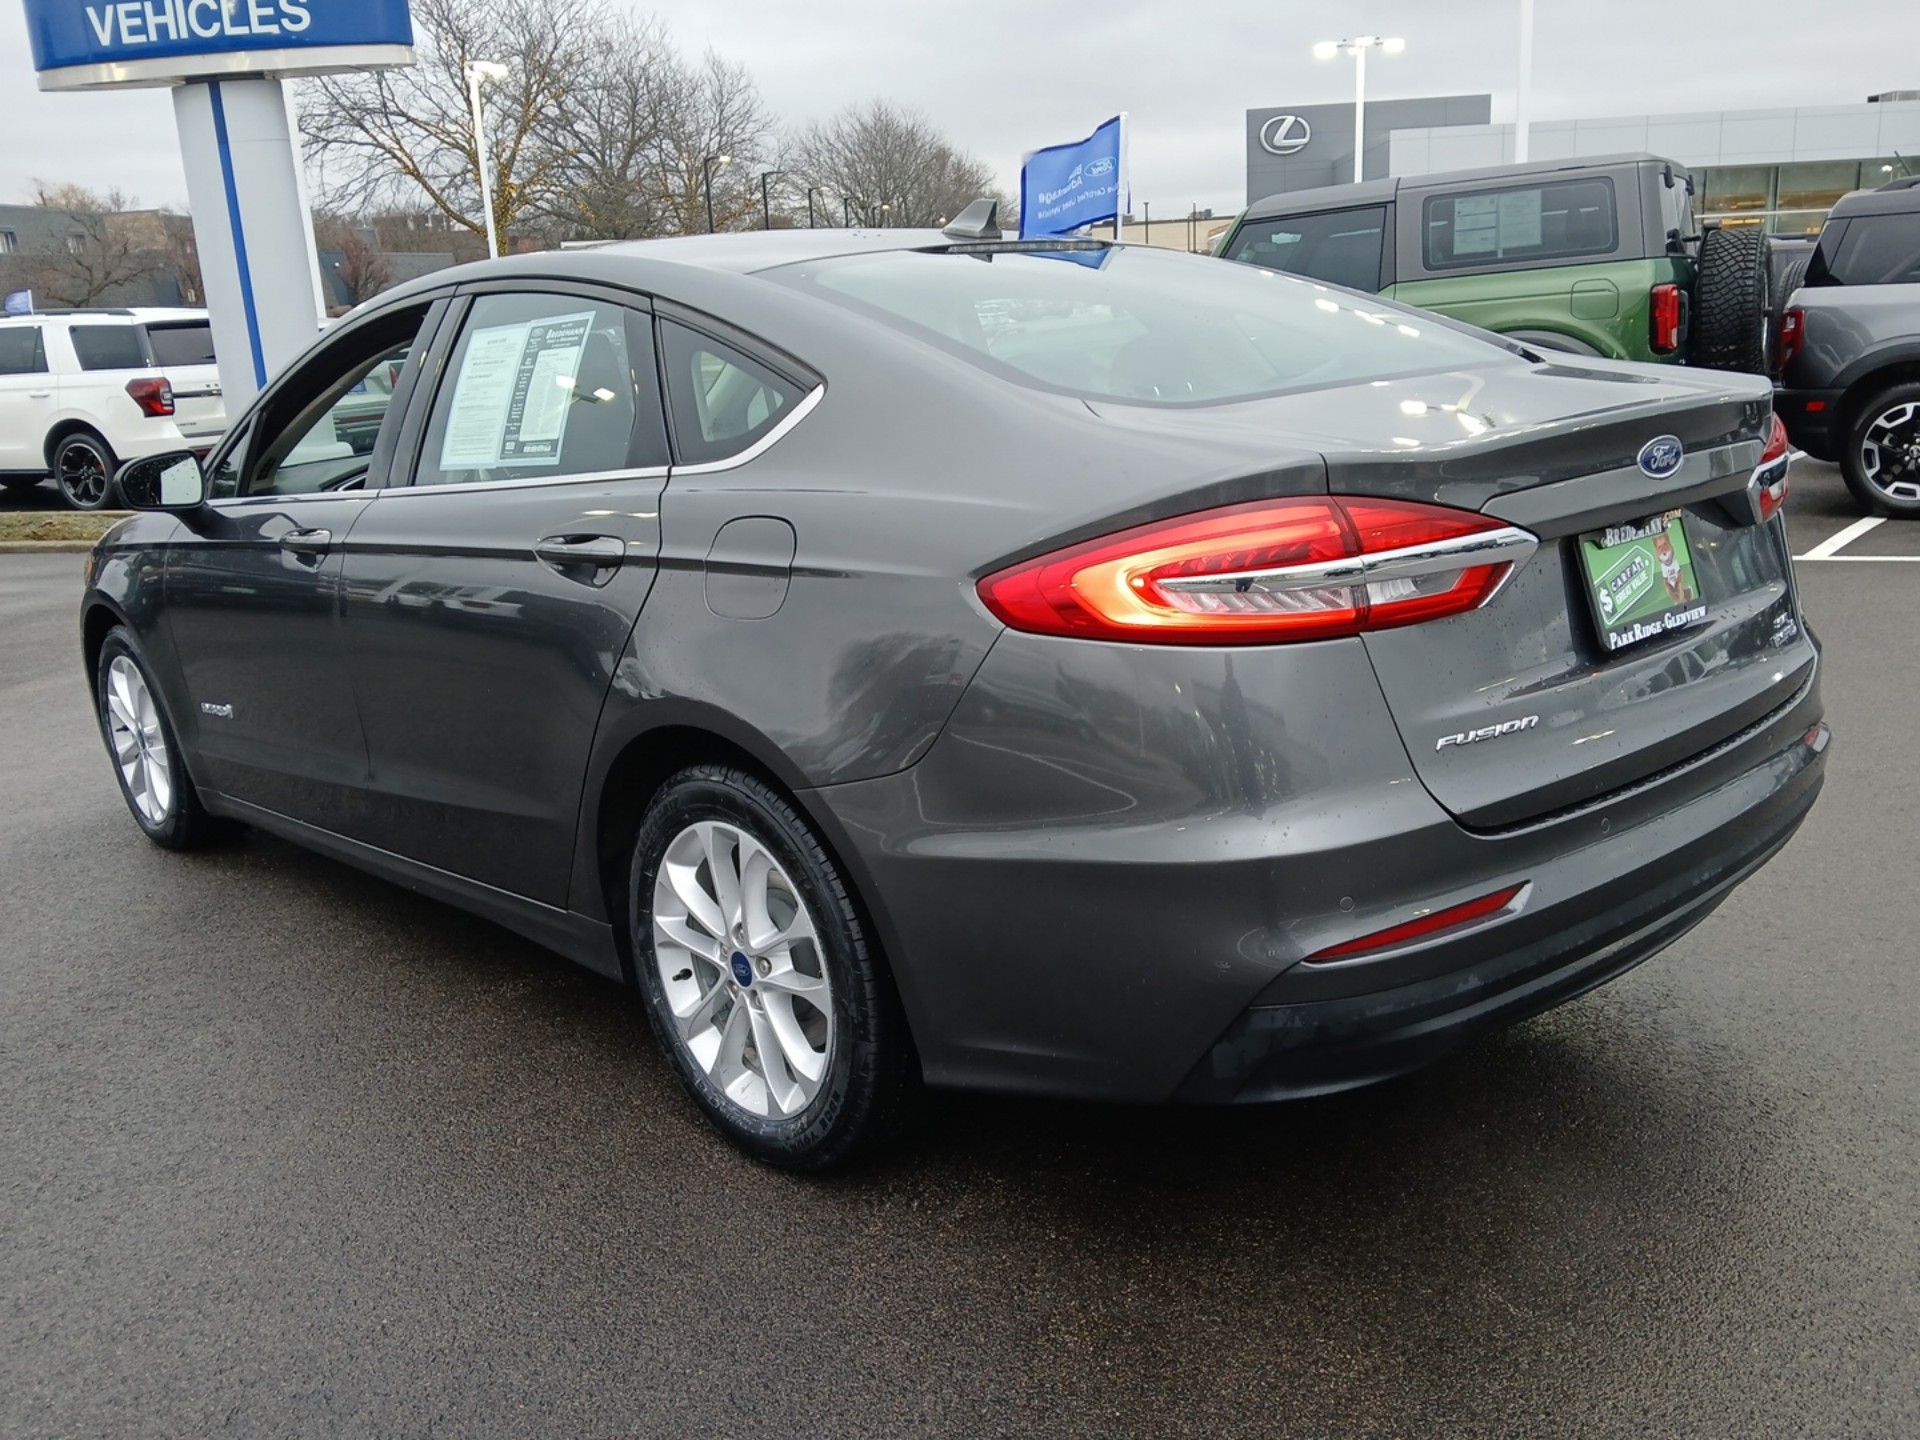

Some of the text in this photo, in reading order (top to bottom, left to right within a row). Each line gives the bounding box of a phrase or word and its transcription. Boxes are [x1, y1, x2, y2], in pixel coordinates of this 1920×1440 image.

[86, 0, 311, 46] VEHICLES
[1651, 444, 1677, 469] Ford
[1436, 715, 1540, 751] FUSION
